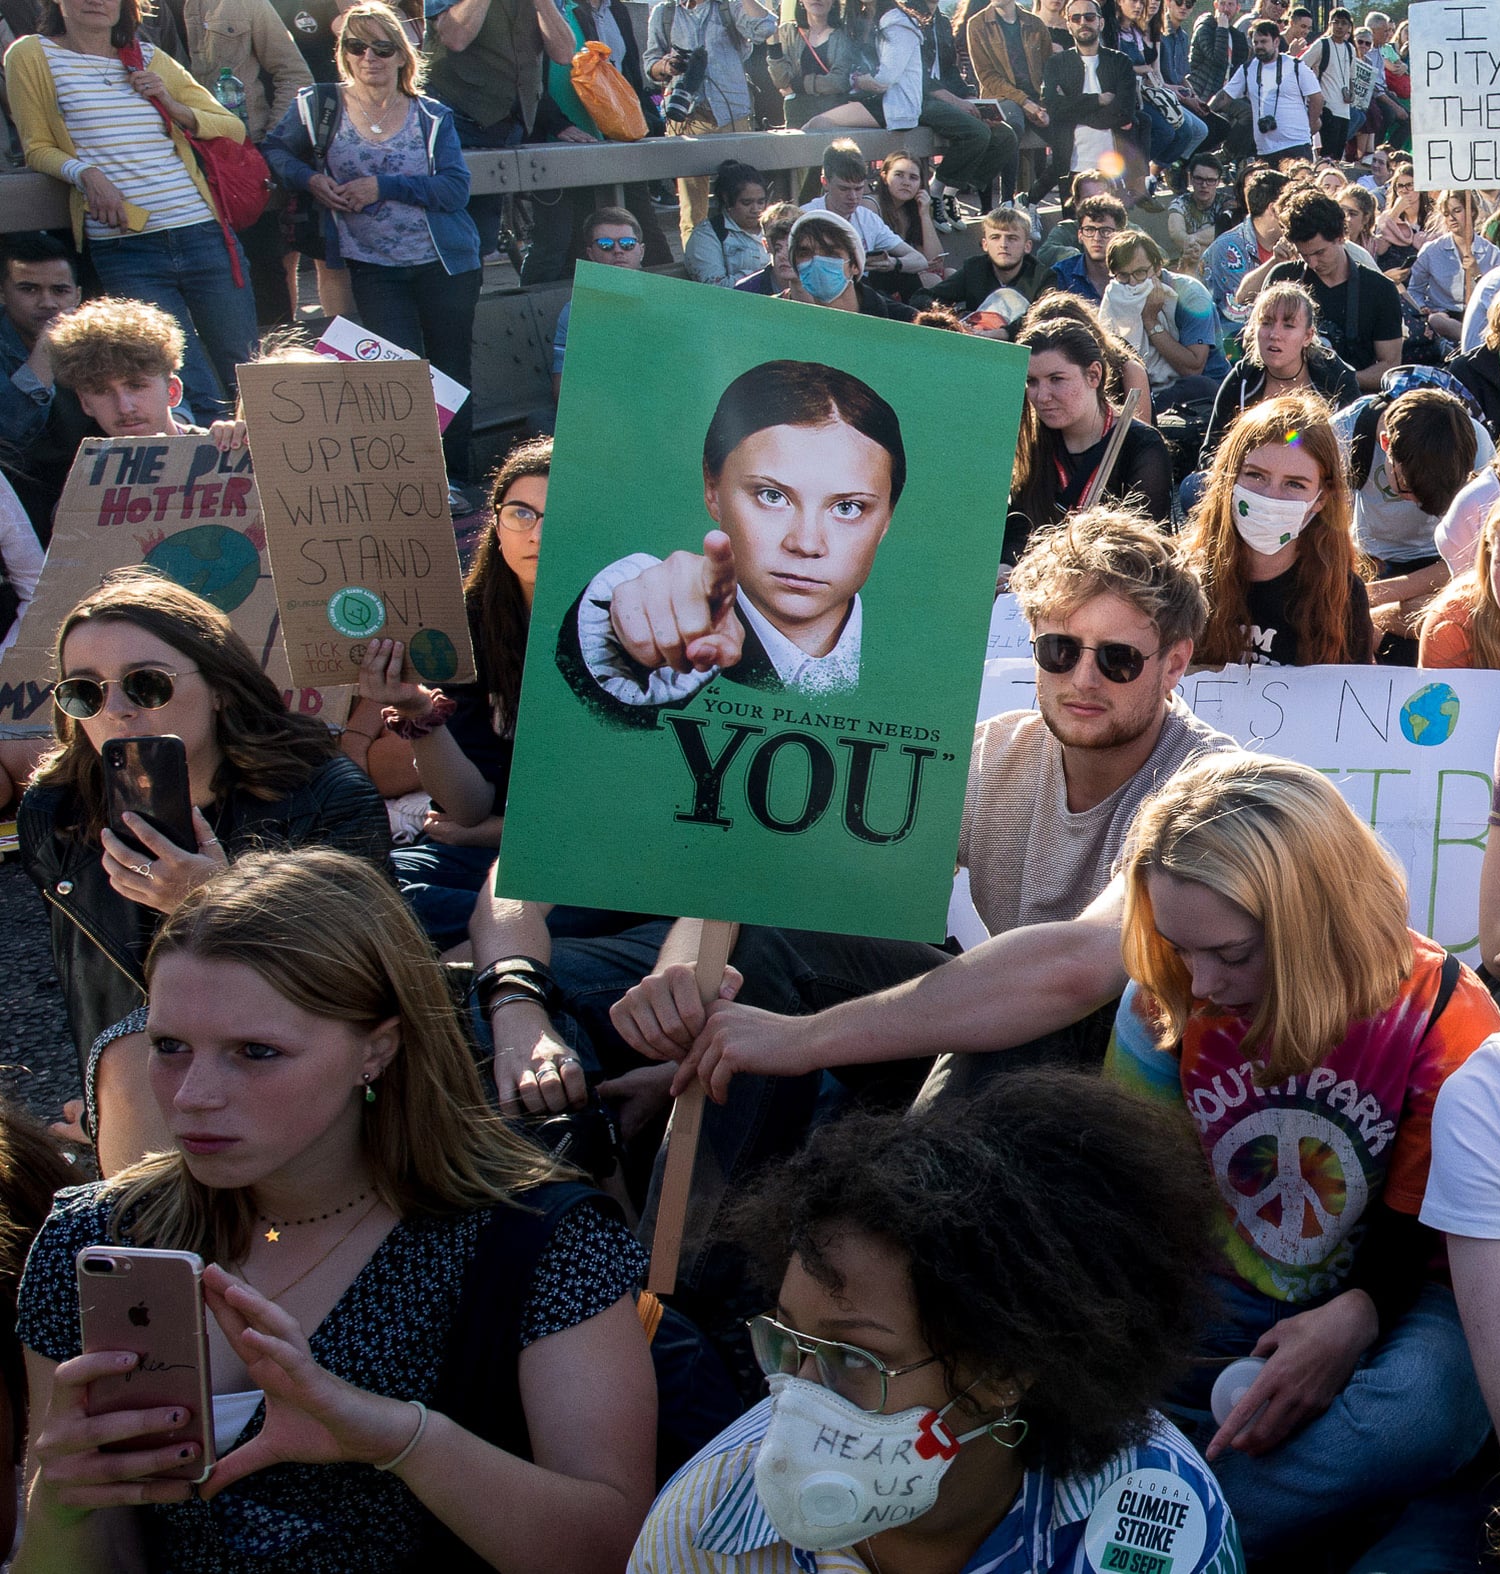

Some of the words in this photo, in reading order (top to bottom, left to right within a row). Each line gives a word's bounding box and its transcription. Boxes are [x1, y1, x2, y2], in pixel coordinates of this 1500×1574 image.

[1444, 7, 1487, 41] I
[269, 381, 413, 424] STAND
[84, 445, 170, 486] THE
[282, 437, 342, 474] UP
[350, 433, 415, 473] FOR
[275, 482, 374, 526] WHAT
[382, 481, 443, 522] YOU
[297, 535, 431, 585] STAND
[383, 588, 423, 627] N!
[301, 641, 342, 658] TICK
[305, 659, 345, 674] TOCK
[772, 708, 860, 732] PLANET
[868, 721, 940, 743] NEEDS
[1306, 1066, 1397, 1158] PARK
[813, 1424, 912, 1465] HEAR
[874, 1475, 923, 1496] US
[1127, 1477, 1190, 1502] GLOBAL
[1117, 1489, 1190, 1529] CLIMATE
[1114, 1517, 1177, 1554] STRIKE
[1109, 1547, 1130, 1570] 20
[1130, 1552, 1167, 1574] SEPT
